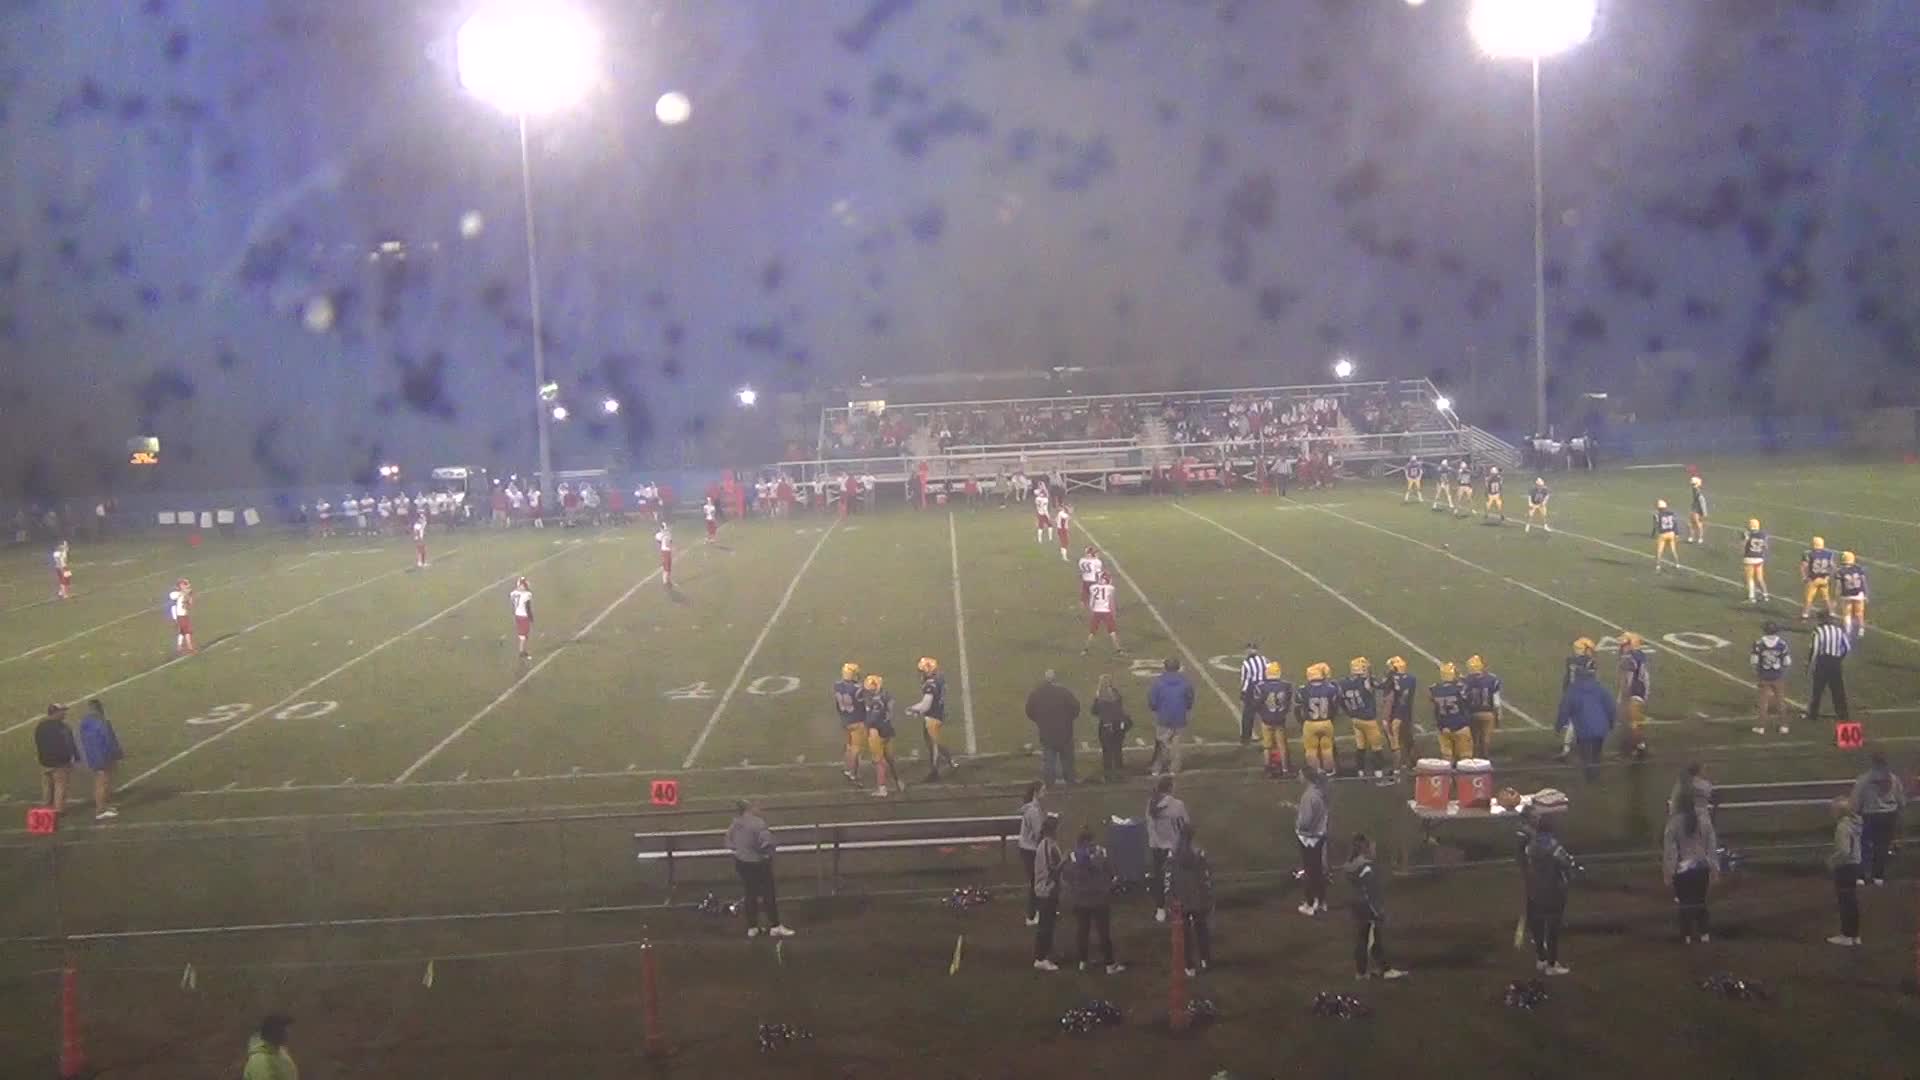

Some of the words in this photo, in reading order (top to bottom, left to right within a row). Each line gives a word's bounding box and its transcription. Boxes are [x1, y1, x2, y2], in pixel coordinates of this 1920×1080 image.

[1093, 586, 1106, 601] 21
[1840, 726, 1862, 746] 40
[1430, 775, 1442, 788] G
[1472, 777, 1484, 789] G
[653, 782, 677, 803] 40
